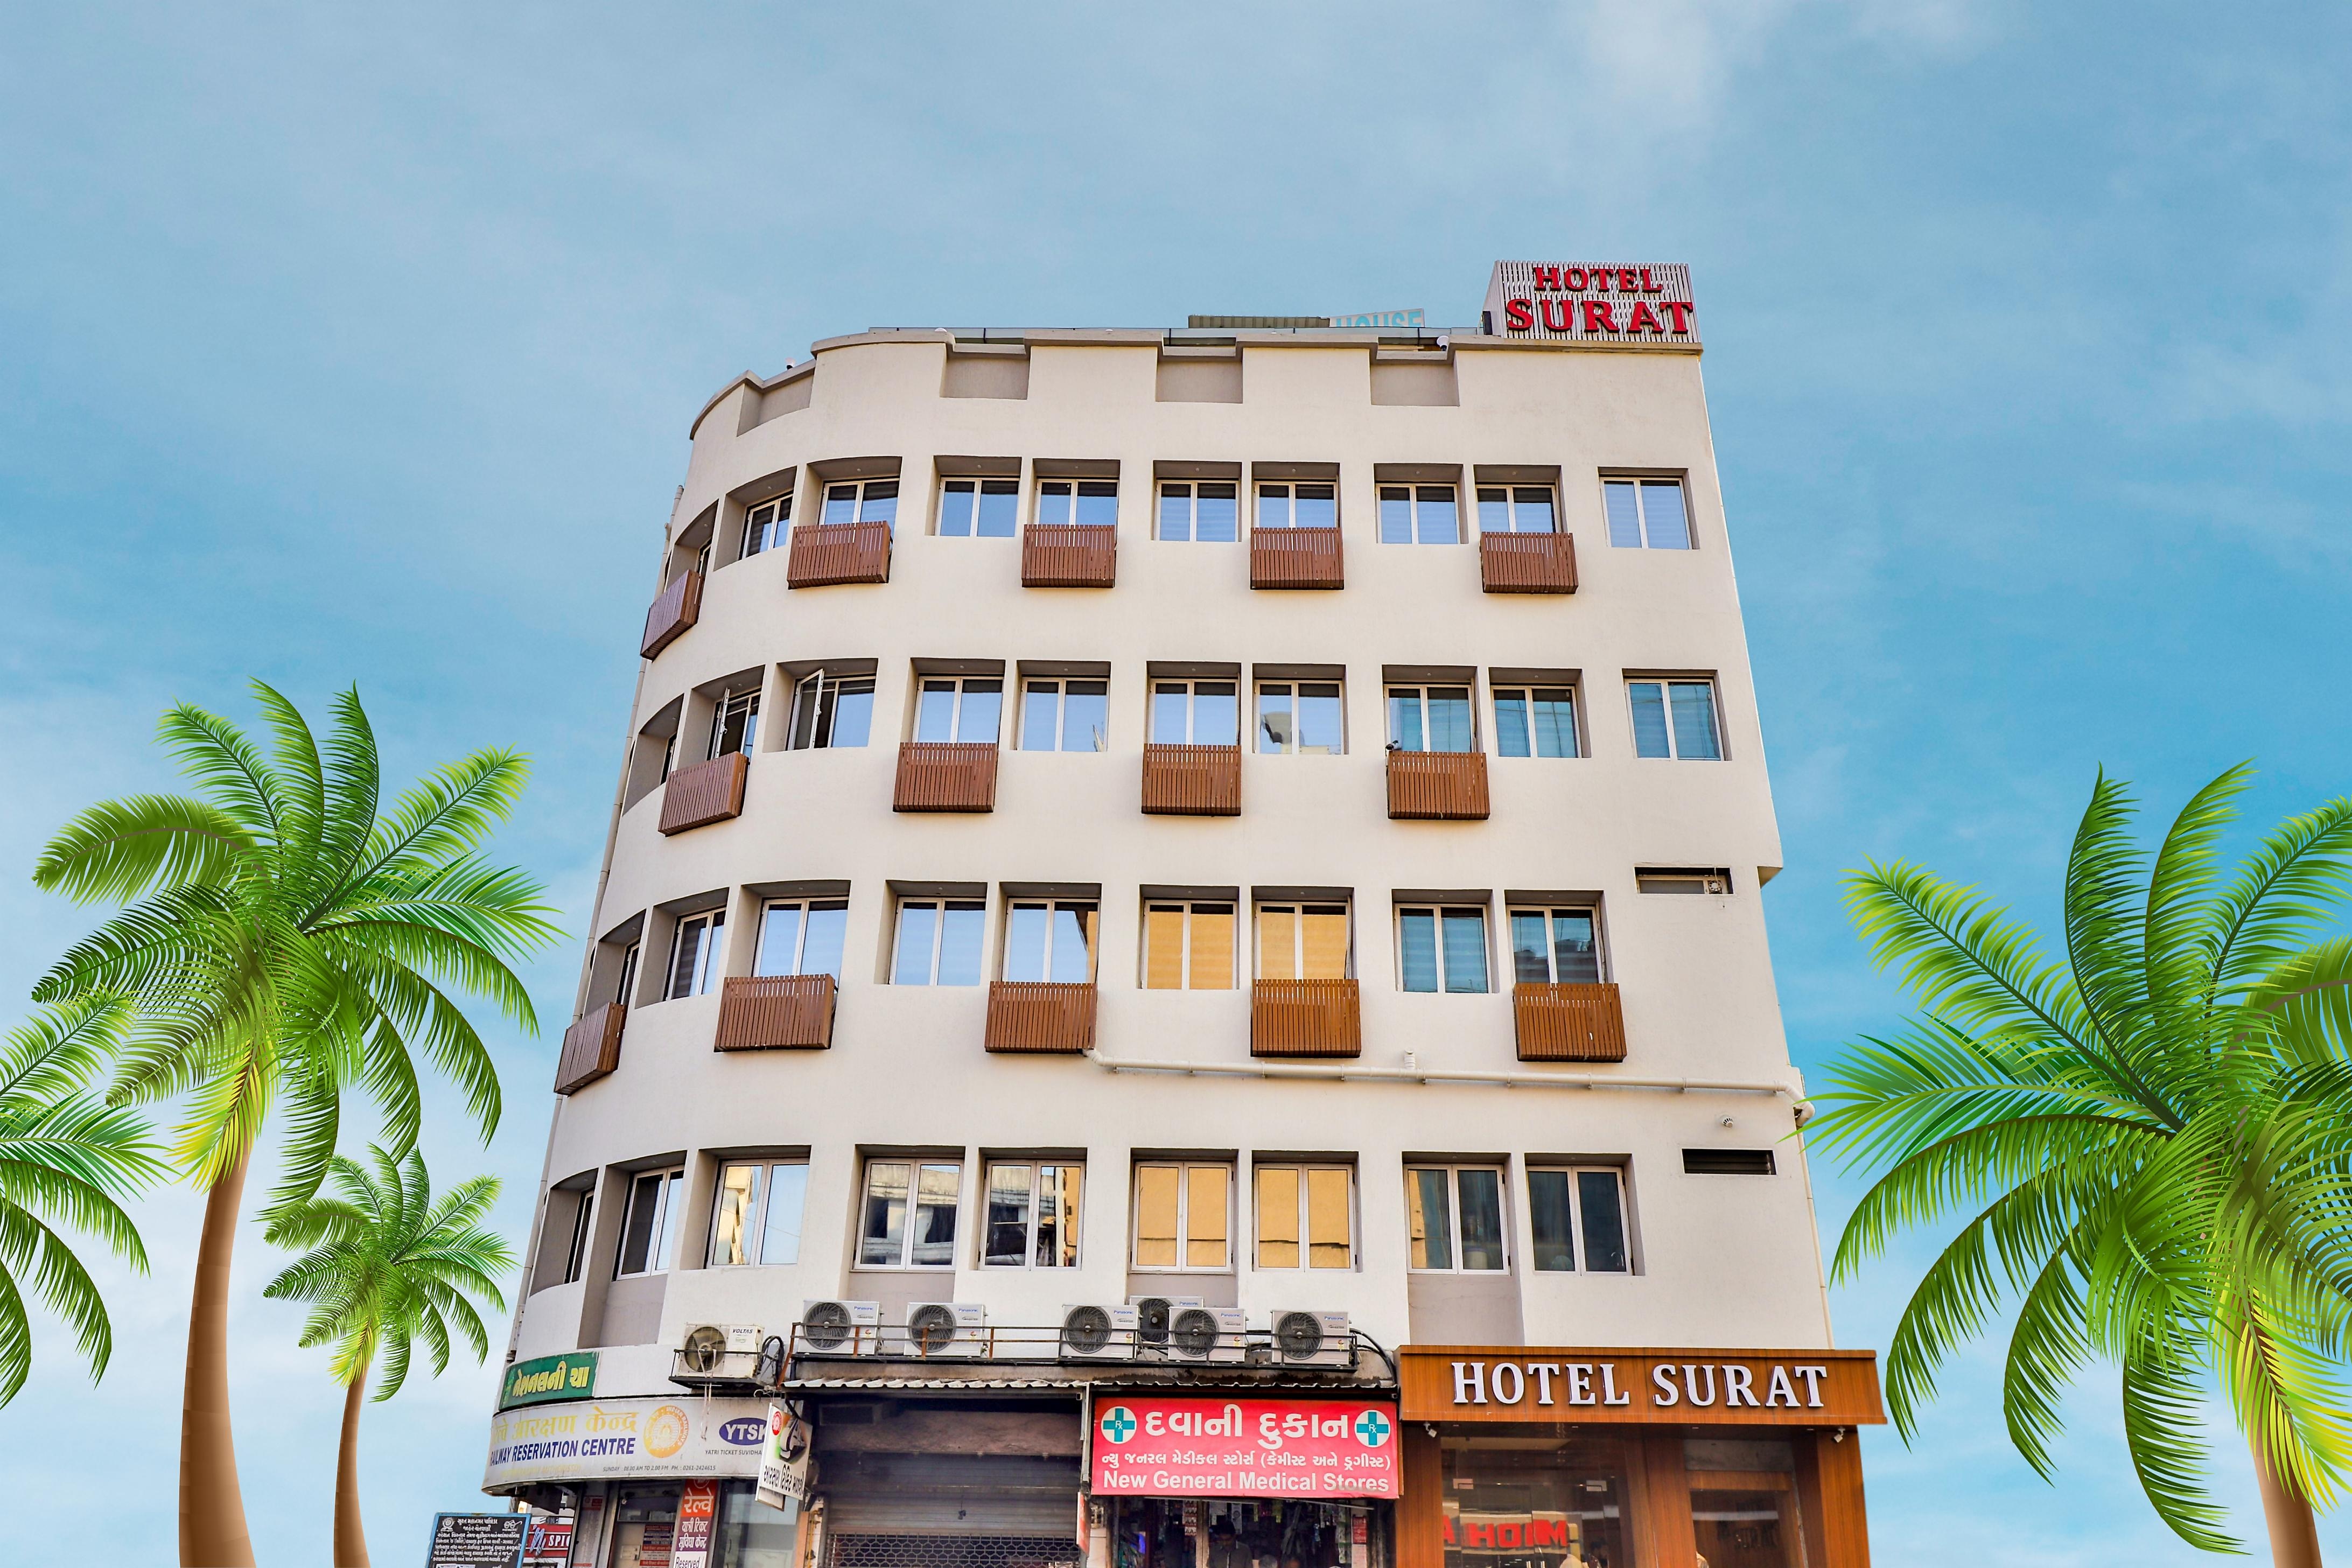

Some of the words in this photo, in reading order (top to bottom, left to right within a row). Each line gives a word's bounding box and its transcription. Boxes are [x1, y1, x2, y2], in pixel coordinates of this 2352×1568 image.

[1533, 267, 1663, 293] HOTEL
[1506, 298, 1694, 335] SURAT
[569, 1367, 590, 1388] ચા
[1451, 1362, 1630, 1406] HOTEL
[1653, 1363, 1828, 1408] SURAT
[512, 1415, 578, 1440] आरक्षण
[585, 1405, 640, 1433] केन्द्र
[1145, 1404, 1243, 1438] દવાની
[1257, 1412, 1349, 1450] દુકાન
[512, 1439, 579, 1462] RESERVATION
[581, 1437, 636, 1457] CENTRE
[1124, 1453, 1167, 1465] જનરલ
[1172, 1449, 1217, 1465] મેડીકલ
[1223, 1450, 1256, 1465] સ્ટોર્સ
[1313, 1452, 1338, 1467] અને
[1103, 1470, 1147, 1488] New
[1153, 1470, 1232, 1489] General
[1239, 1472, 1317, 1491] Medical
[1323, 1473, 1389, 1493] Stores
[683, 1487, 714, 1513] रेल्वे
[682, 1517, 694, 1532] यात्री
[694, 1517, 709, 1532] टिकट
[676, 1557, 701, 1568] Reserved
